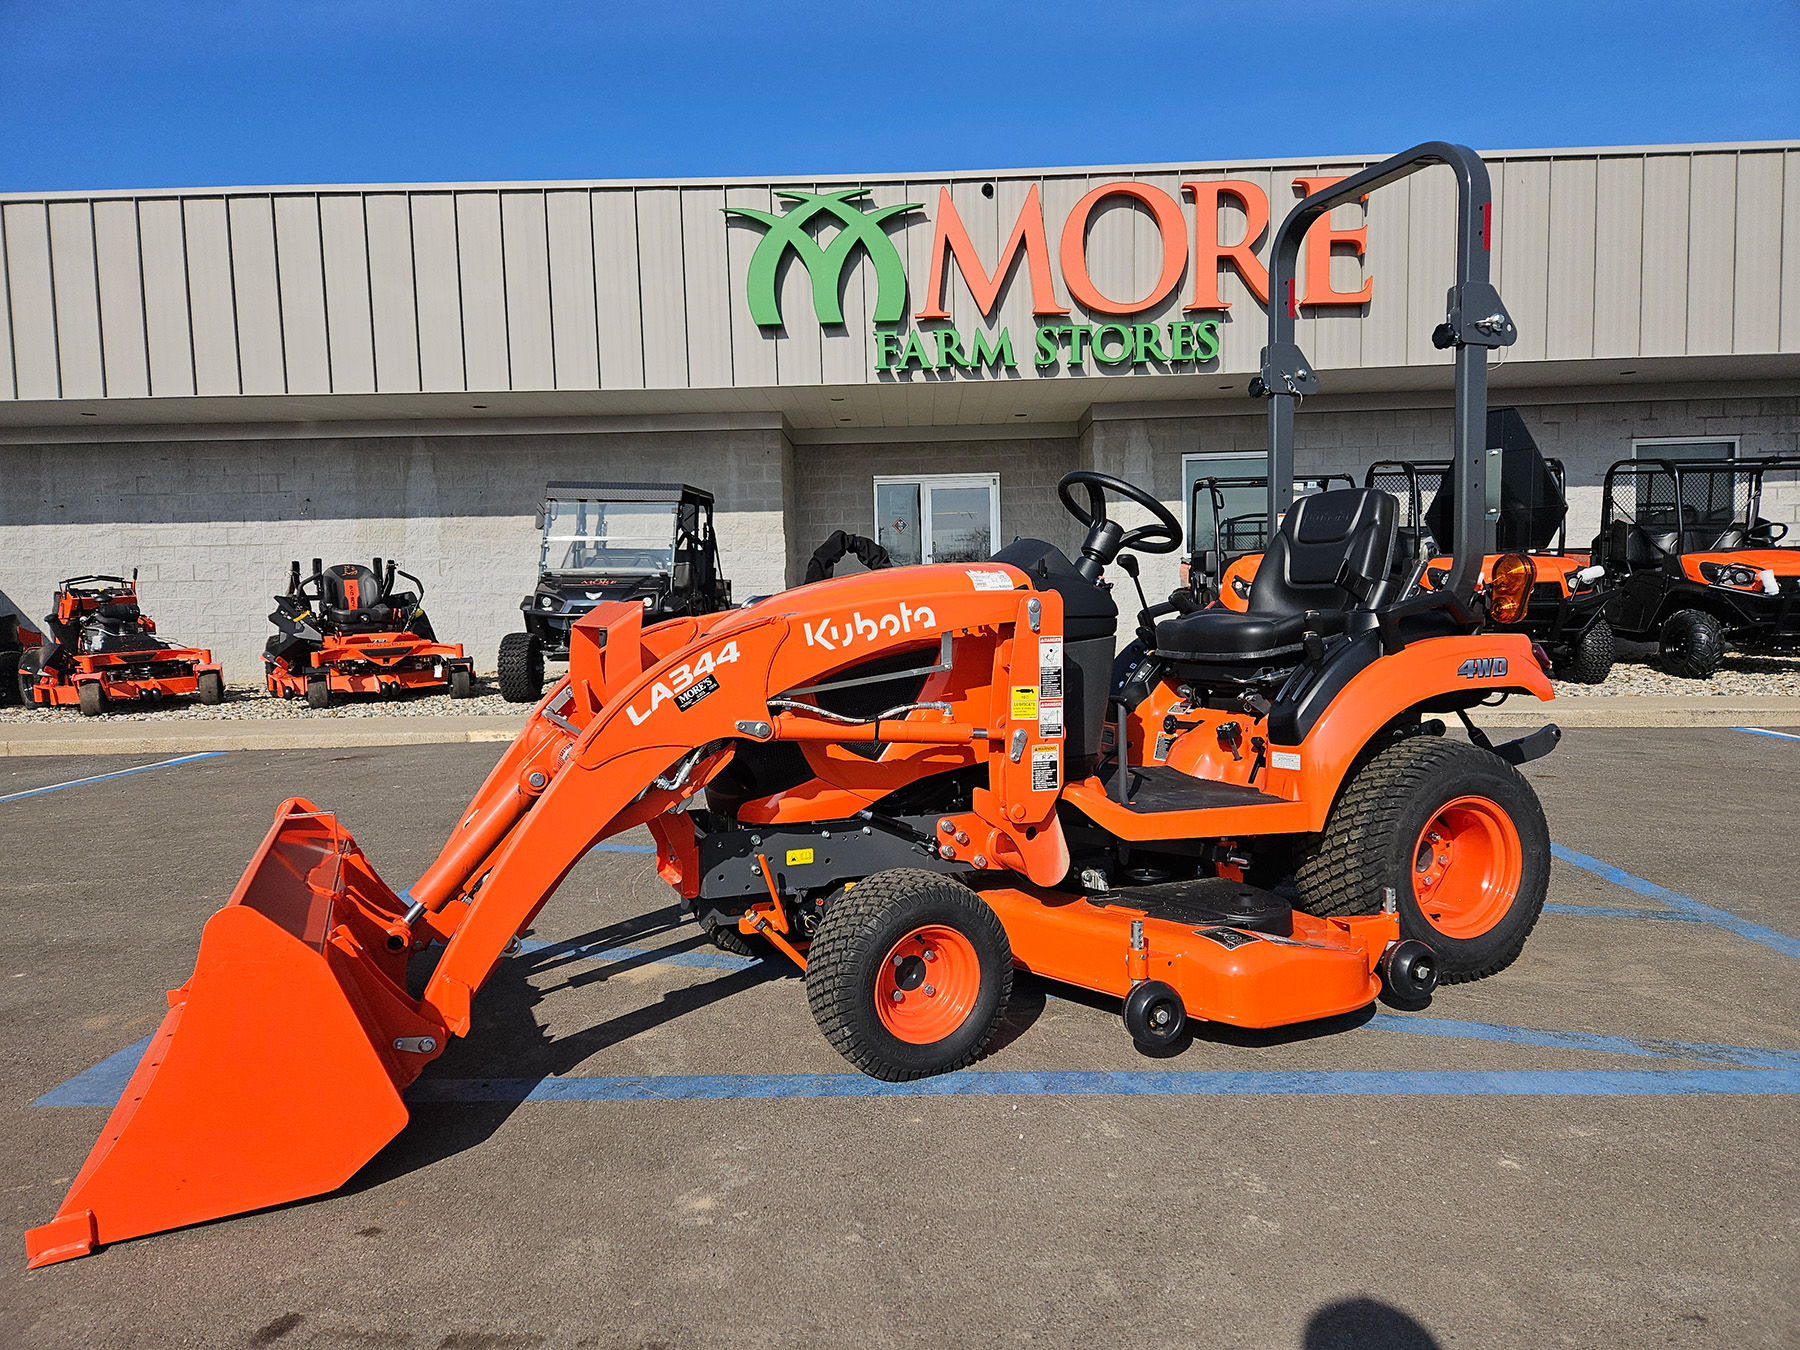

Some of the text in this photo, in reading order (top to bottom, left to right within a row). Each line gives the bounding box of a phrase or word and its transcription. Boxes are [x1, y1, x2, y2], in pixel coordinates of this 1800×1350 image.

[914, 175, 1374, 320] MORE
[873, 319, 1220, 372] FARM STORES
[803, 601, 937, 651] Kubota
[625, 640, 741, 727] LA344
[677, 676, 713, 704] MORE'S
[1457, 656, 1508, 679] 4WD
